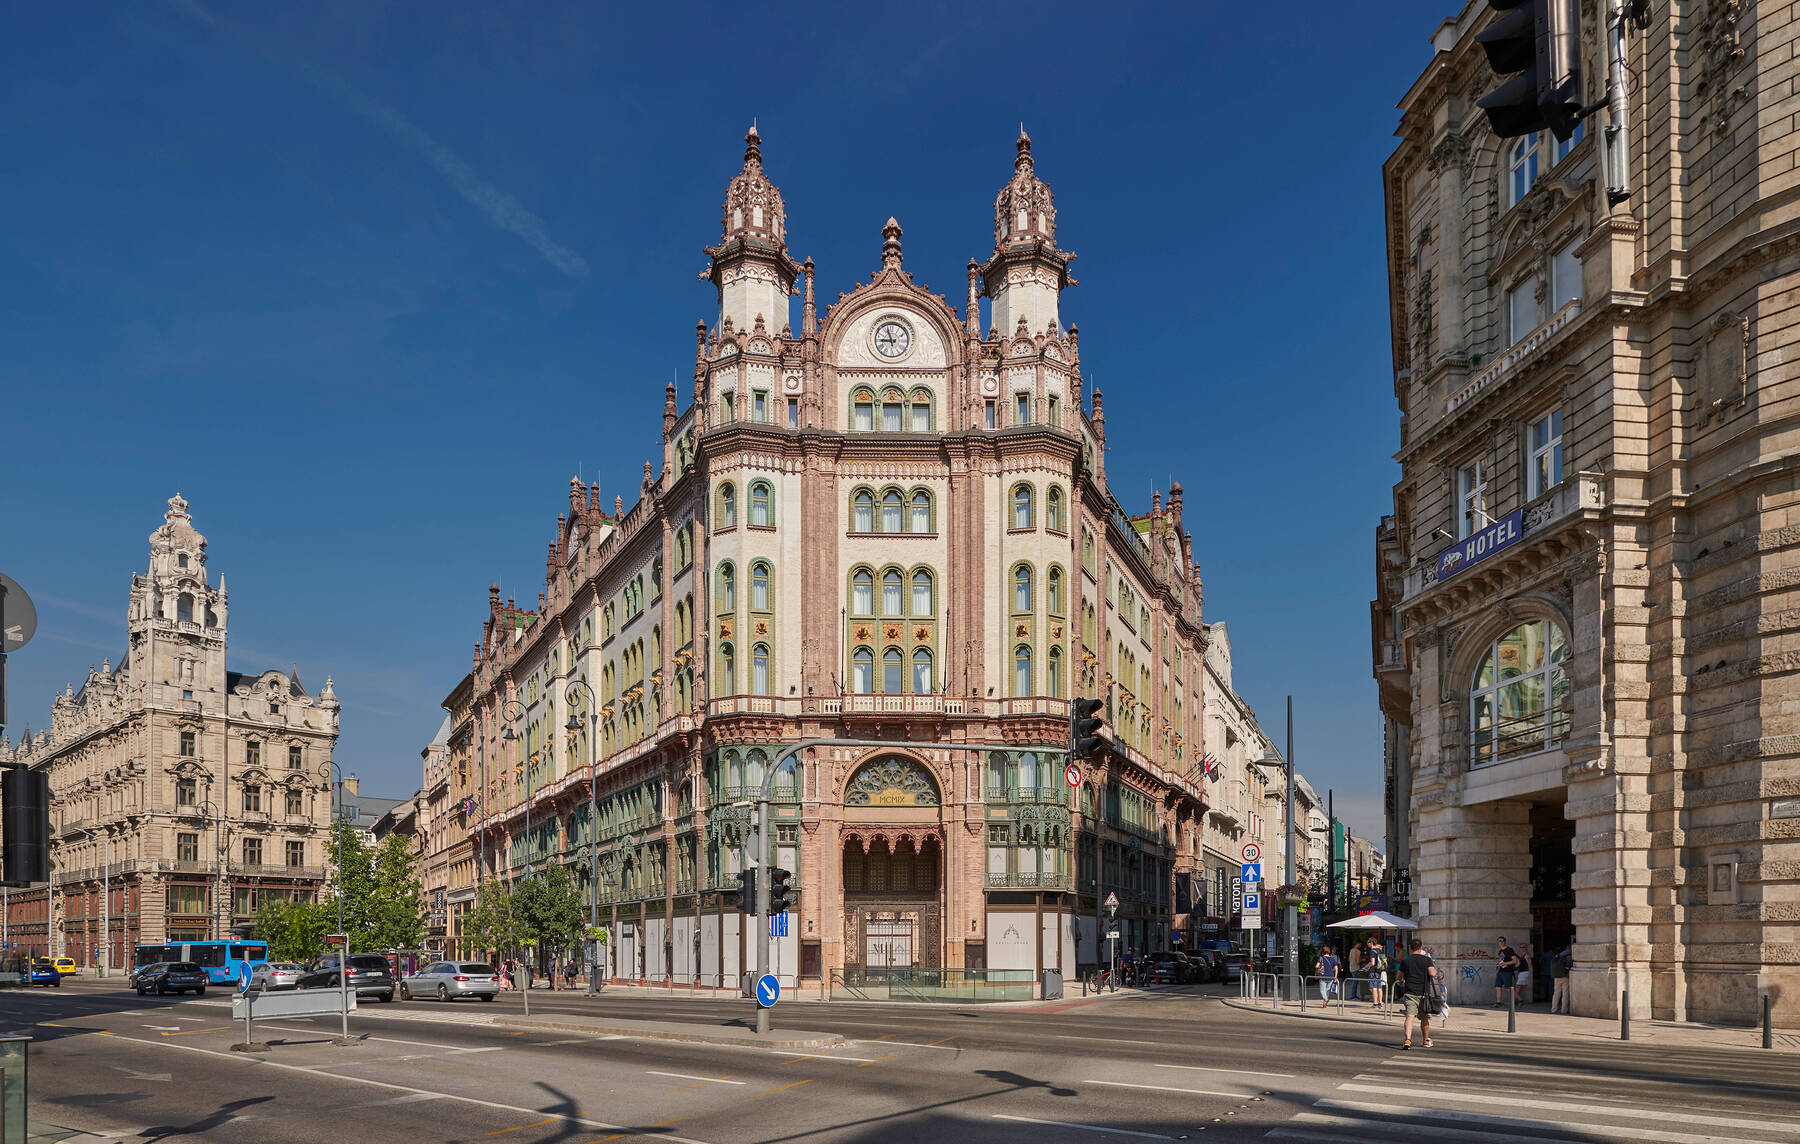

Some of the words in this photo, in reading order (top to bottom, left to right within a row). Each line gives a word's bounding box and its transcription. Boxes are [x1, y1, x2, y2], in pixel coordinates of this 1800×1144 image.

[1466, 519, 1517, 562] HOTEL
[879, 795, 905, 804] MCMIX
[1246, 849, 1256, 857] 30
[1246, 895, 1256, 908] P
